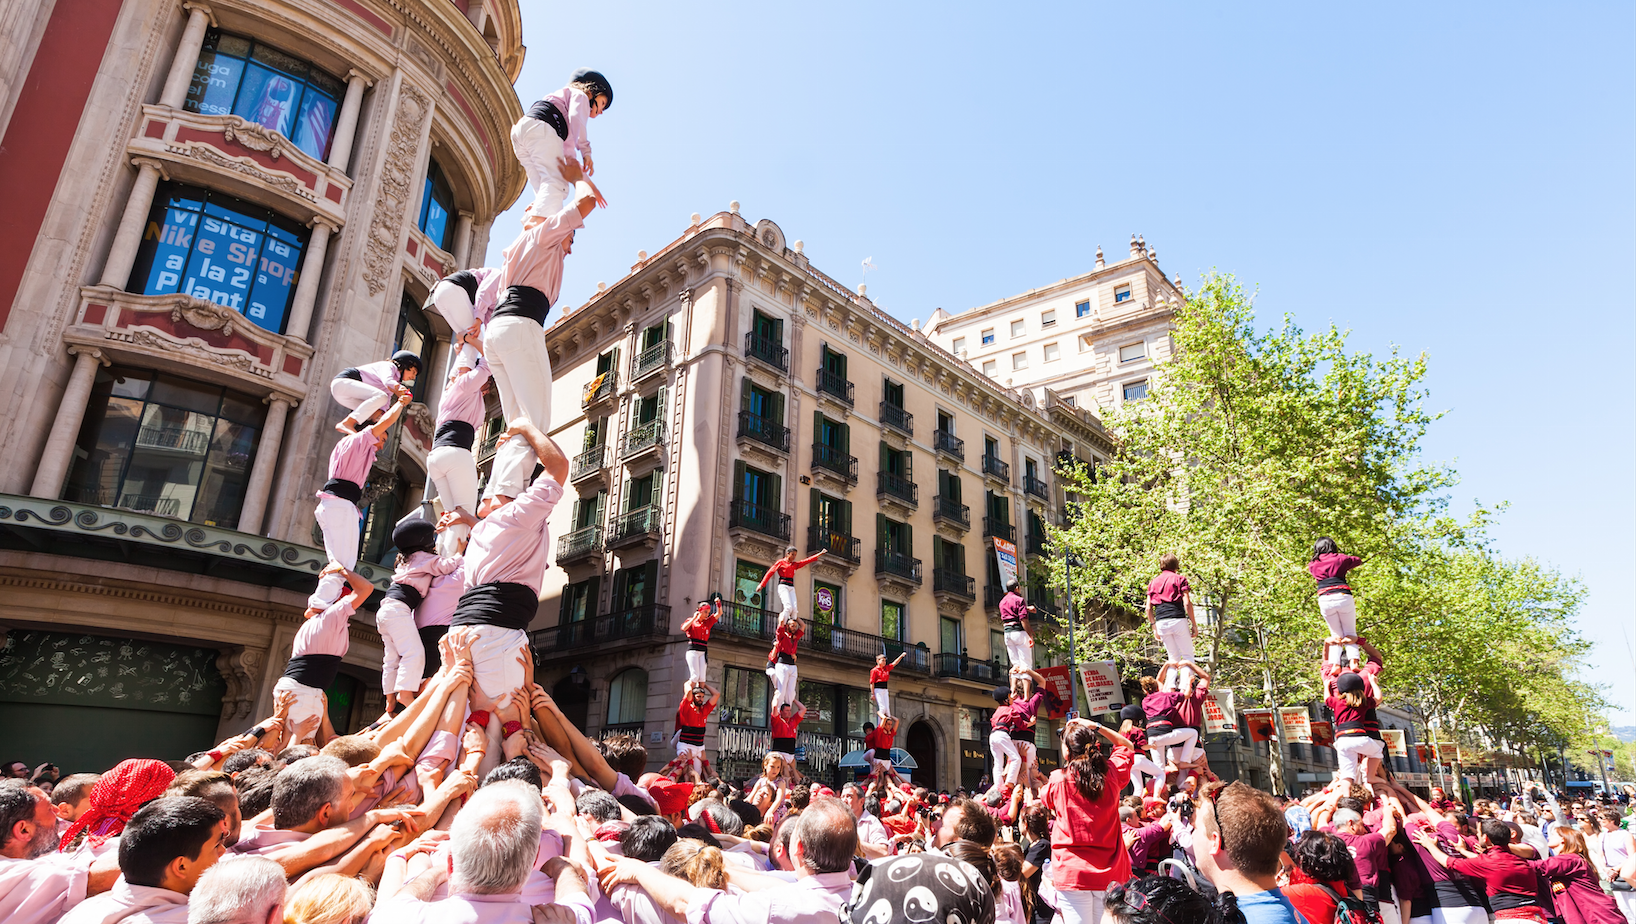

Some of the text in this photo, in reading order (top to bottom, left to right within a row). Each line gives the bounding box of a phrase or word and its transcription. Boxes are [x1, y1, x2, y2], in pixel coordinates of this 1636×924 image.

[187, 85, 203, 96] el
[191, 73, 227, 89] com
[184, 98, 232, 115] messi
[145, 221, 299, 286] Nike Shop
[268, 232, 291, 258] la
[165, 254, 184, 271] a
[199, 257, 226, 283] la
